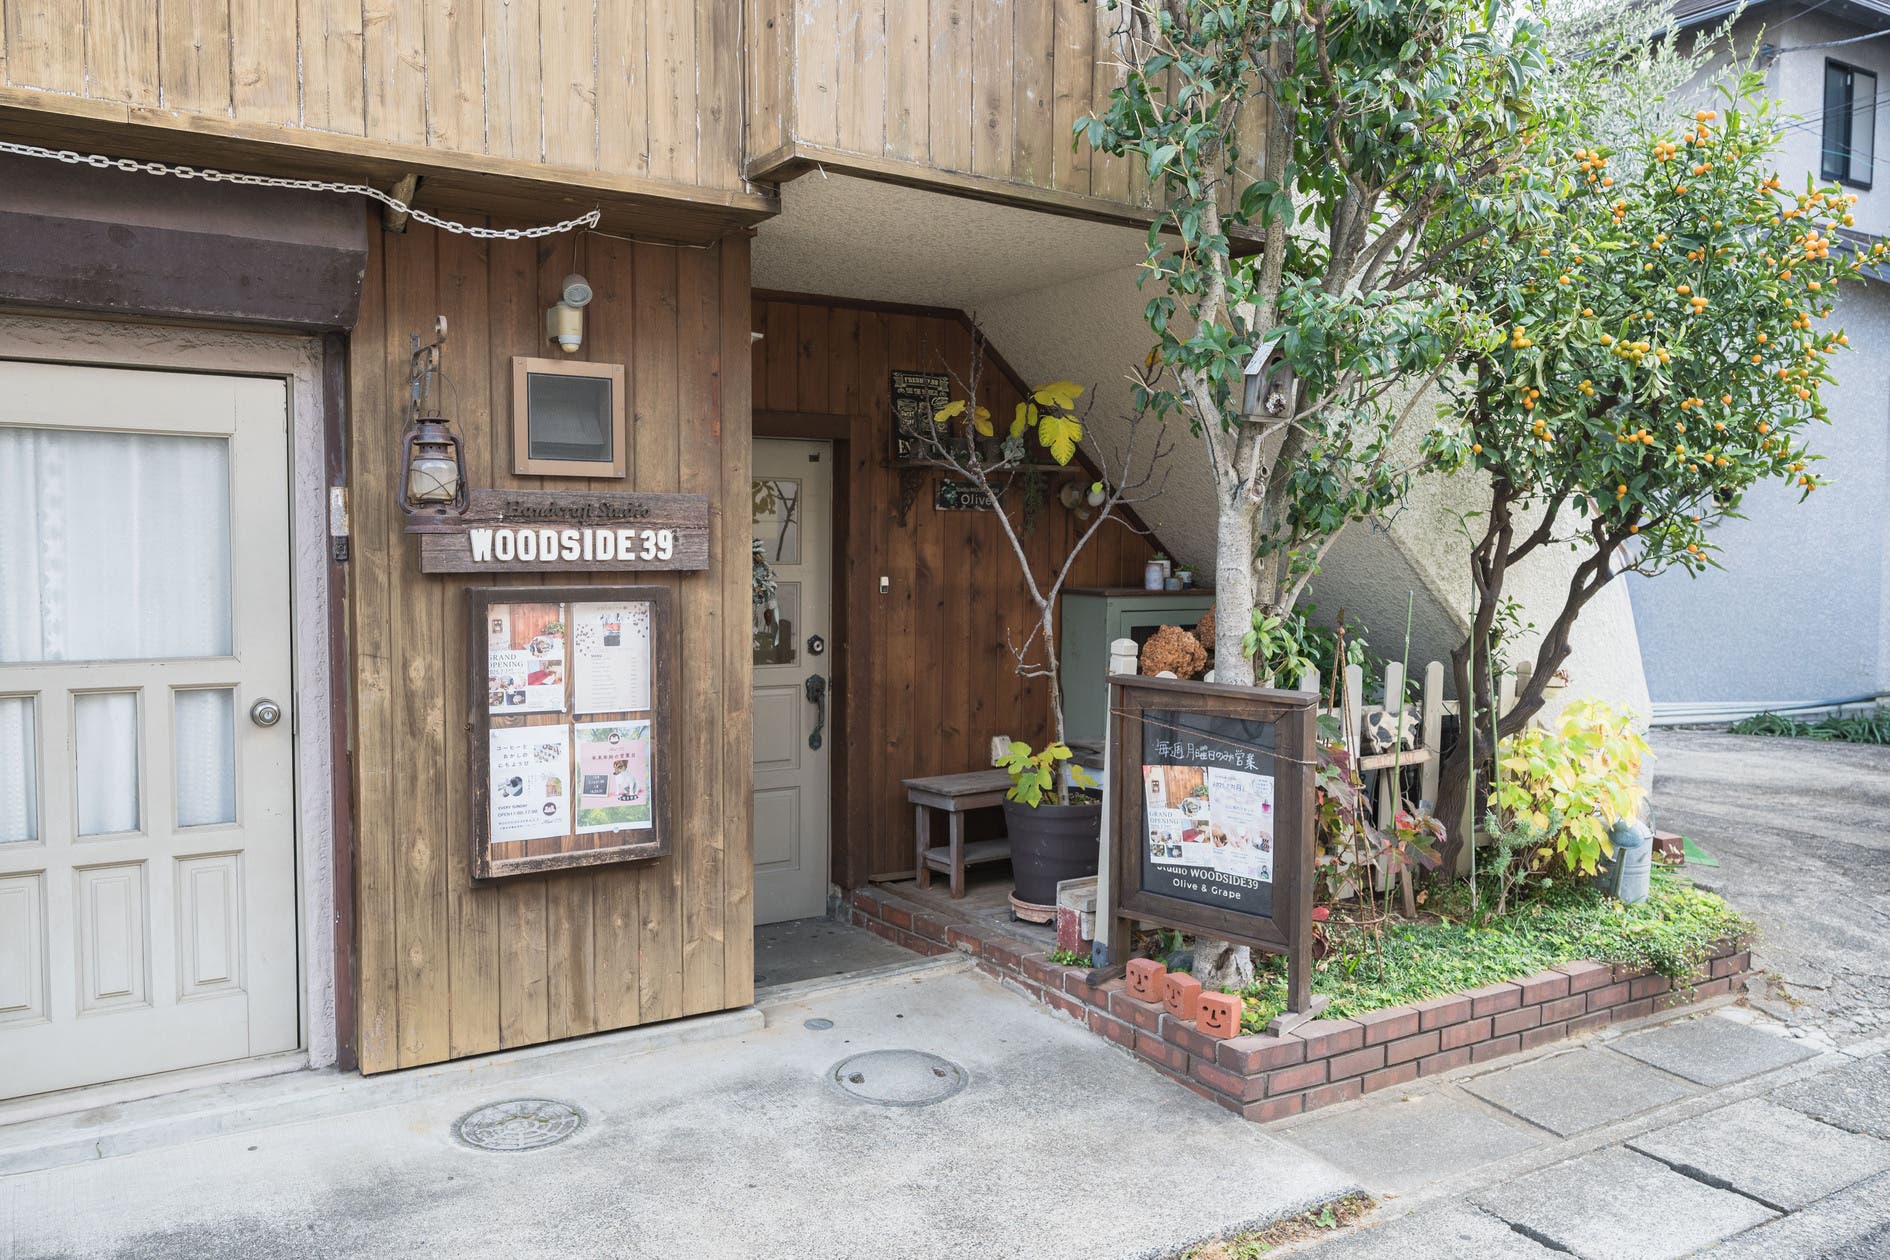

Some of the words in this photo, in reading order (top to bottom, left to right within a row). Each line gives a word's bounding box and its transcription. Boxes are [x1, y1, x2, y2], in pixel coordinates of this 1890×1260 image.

[598, 502, 651, 519] Studio
[961, 493, 992, 506] Olive
[1155, 740, 1259, 770] 毎週月曜日のみ営業
[1172, 878, 1199, 891] Olive
[1200, 884, 1208, 893] &
[1211, 886, 1242, 900] Grape
[1190, 868, 1259, 890] WOODSIDE39
